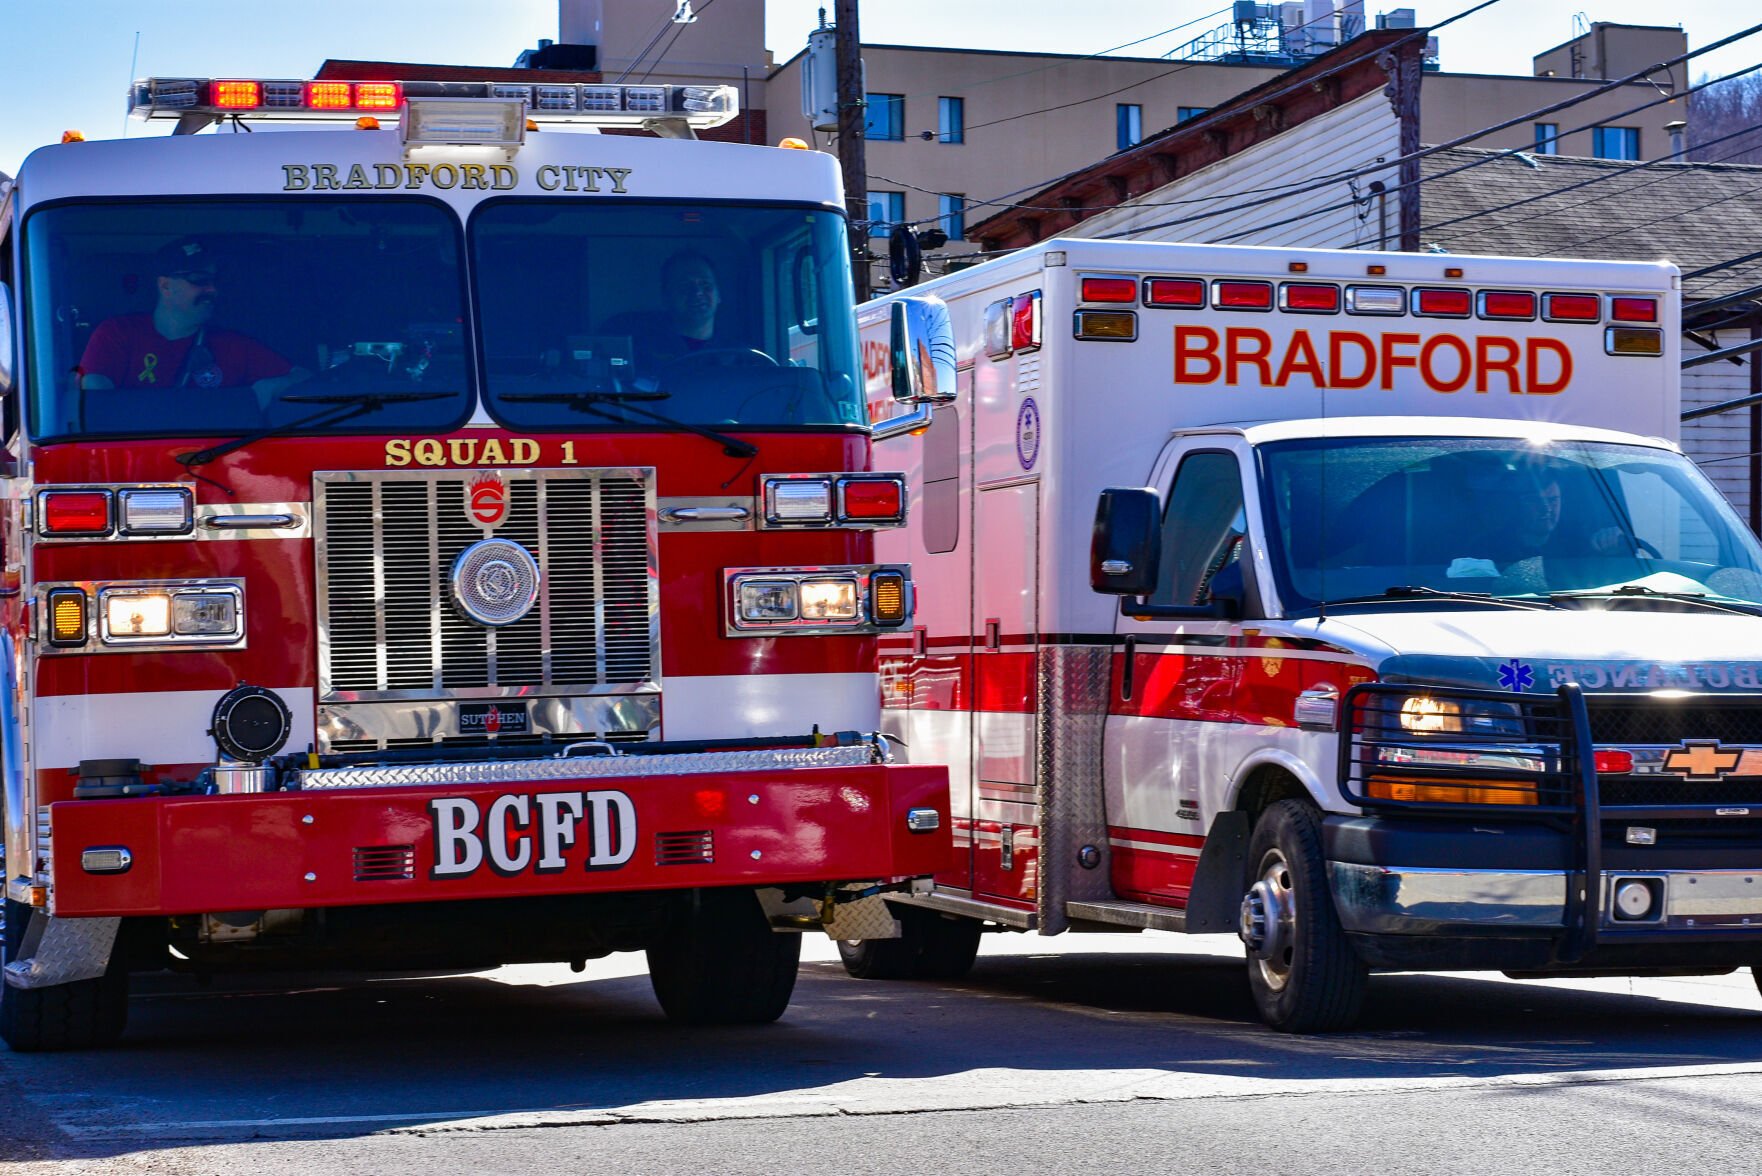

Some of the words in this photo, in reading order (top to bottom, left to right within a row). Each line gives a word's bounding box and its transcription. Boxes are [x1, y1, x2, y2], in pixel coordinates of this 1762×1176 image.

[282, 163, 519, 190] BRADFORD
[536, 164, 632, 193] CITY
[1173, 325, 1573, 395] BRADFORD
[384, 438, 541, 466] SQUAD
[560, 441, 578, 464] 1
[461, 712, 525, 725] SUTPHEN
[428, 789, 638, 879] BCFD
